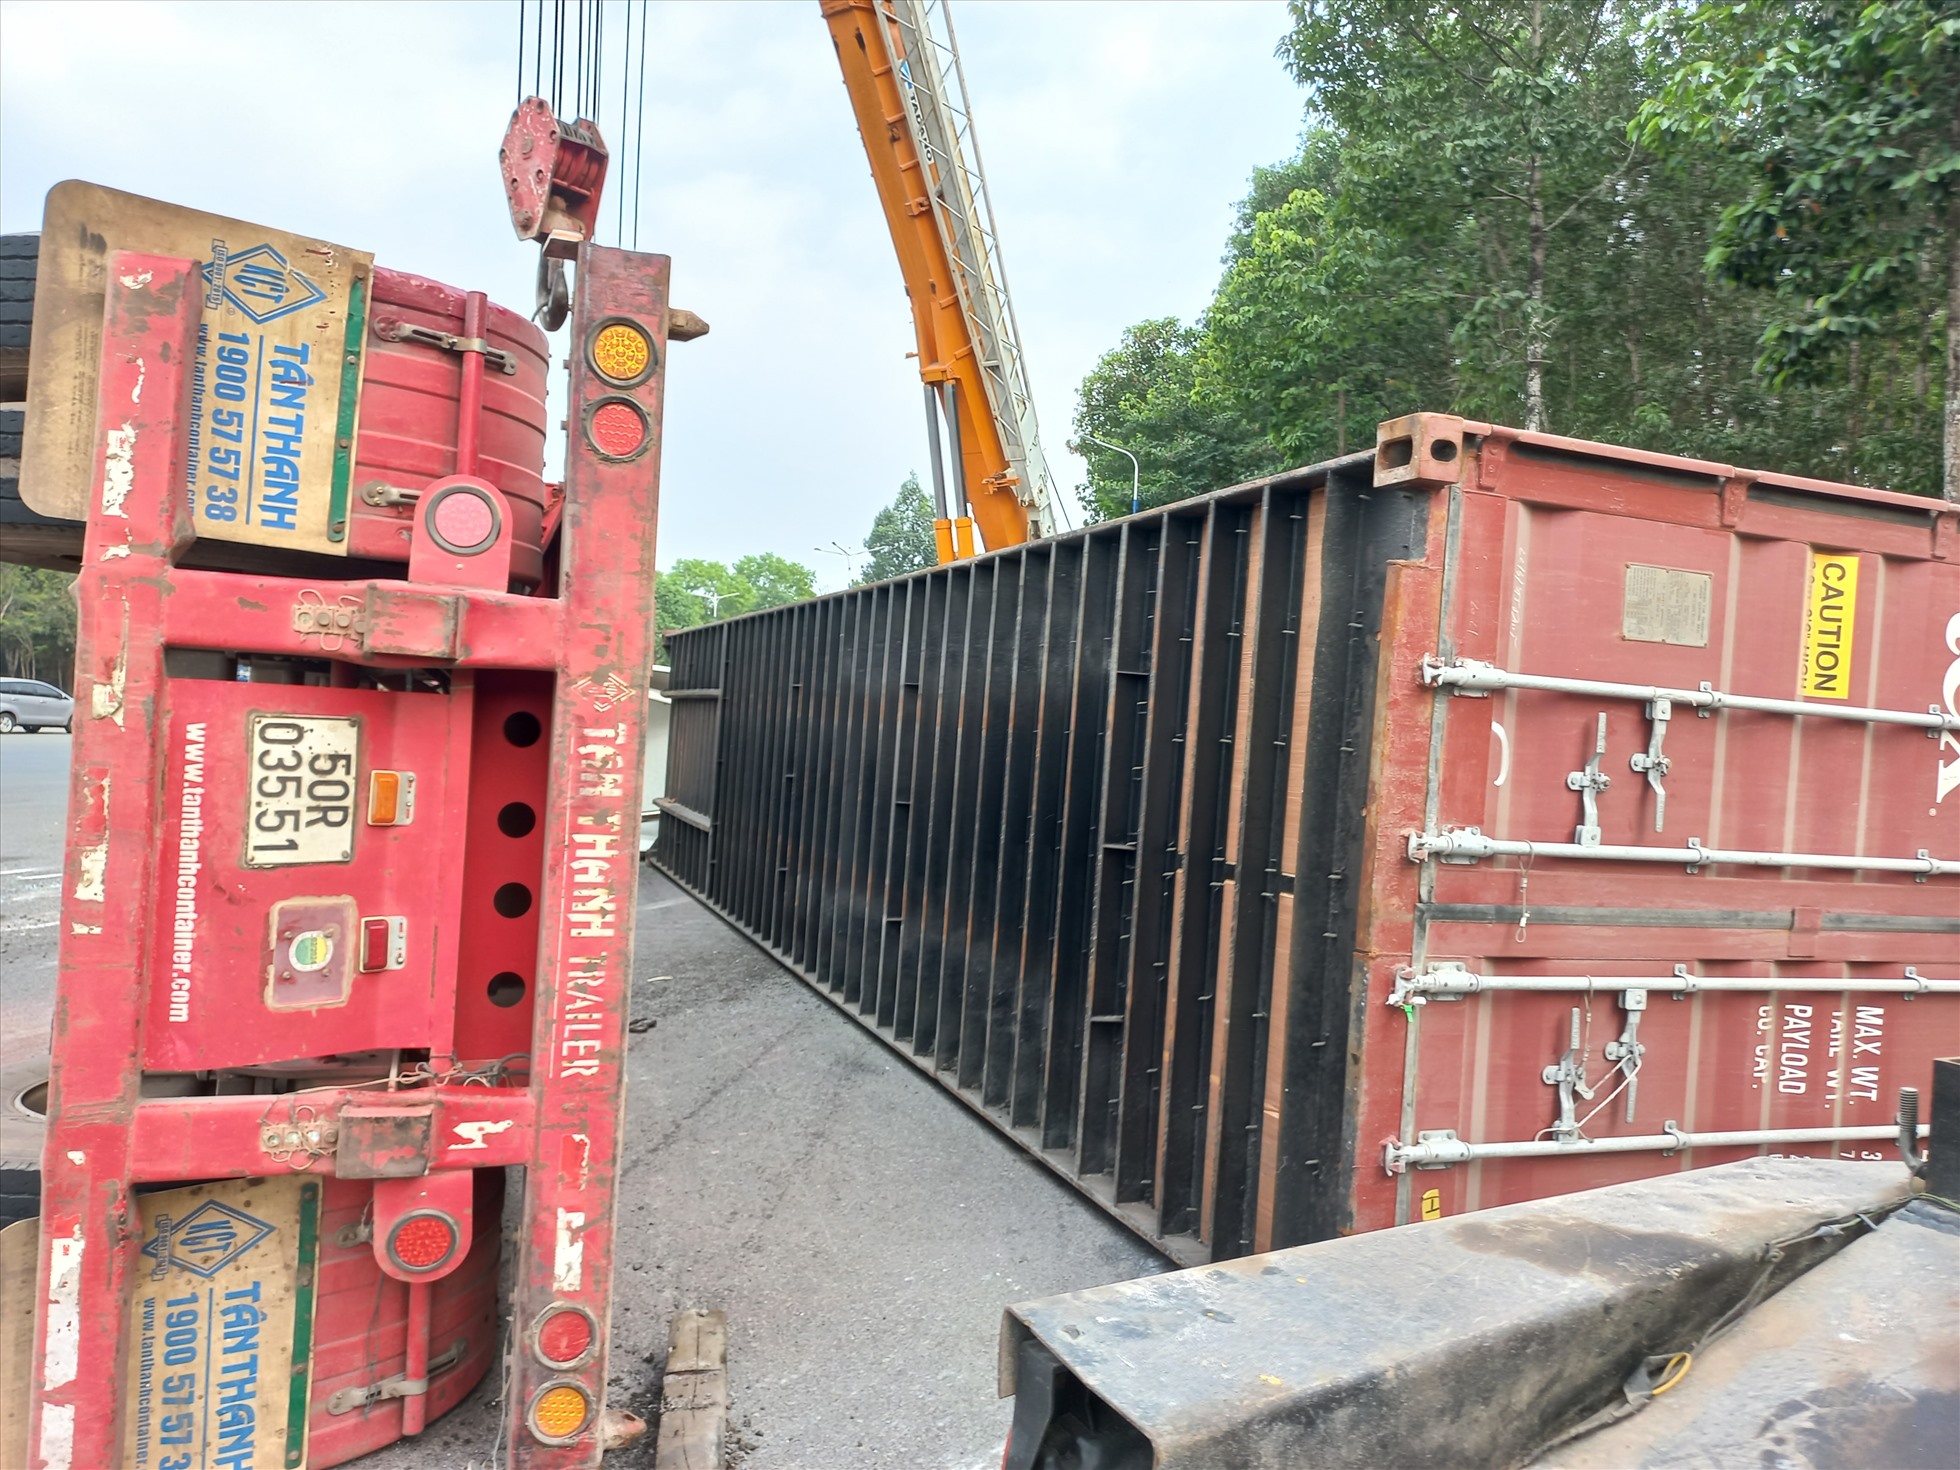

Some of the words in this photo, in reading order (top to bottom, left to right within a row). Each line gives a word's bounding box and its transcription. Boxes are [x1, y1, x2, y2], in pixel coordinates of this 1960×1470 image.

[214, 332, 250, 402] 1900
[210, 408, 244, 445] 57
[208, 447, 241, 482] 57
[204, 483, 238, 522] 38
[1813, 562, 1846, 692] CAUTION
[252, 722, 304, 853] 035.51
[304, 753, 351, 828] 50R
[168, 723, 207, 1023] www.tanthanhcontainer.com
[560, 951, 609, 1077] TRAILER
[1852, 1006, 1884, 1059] MAX.
[1778, 1004, 1813, 1094] PAYLOAD
[1848, 1066, 1880, 1105] WT.
[62, 1244, 70, 1256] 3M
[162, 1292, 199, 1366] 1900
[162, 1374, 195, 1407] 57
[160, 1412, 194, 1446] 57
